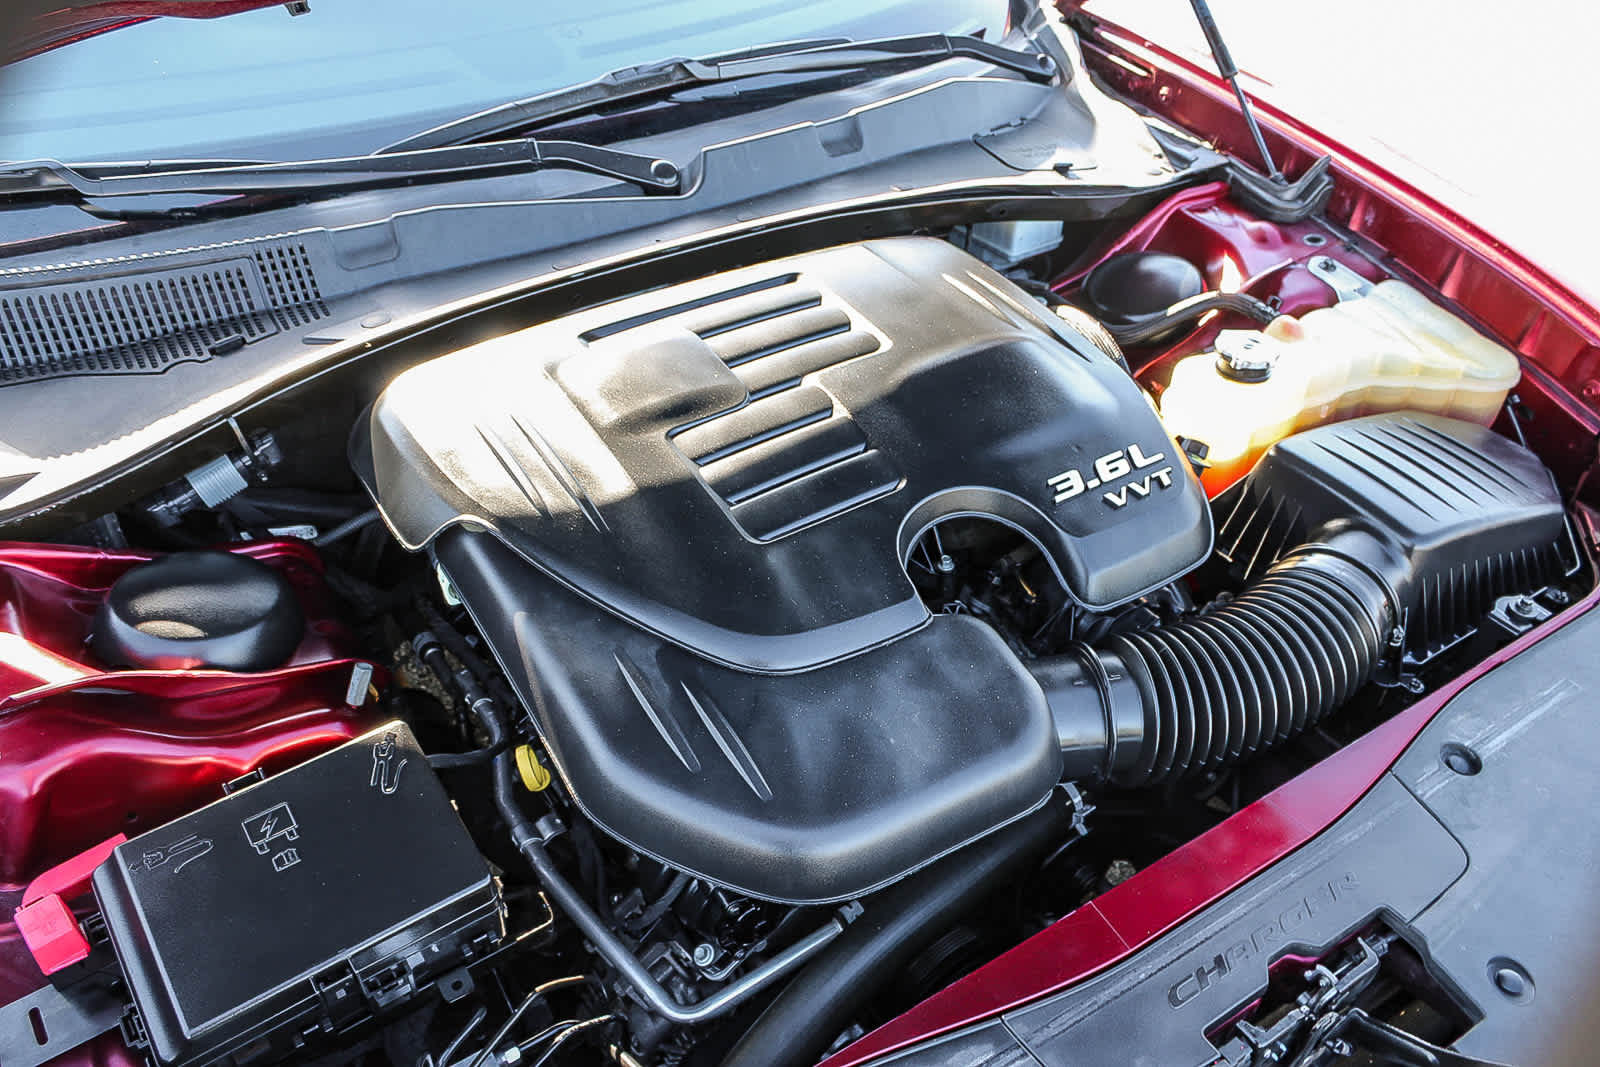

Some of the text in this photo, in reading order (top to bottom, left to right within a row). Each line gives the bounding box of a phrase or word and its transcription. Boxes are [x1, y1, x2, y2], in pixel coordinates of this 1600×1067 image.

[1047, 443, 1165, 504] 3.6L
[1103, 466, 1173, 508] VVT
[1168, 871, 1361, 1009] CHARGER
